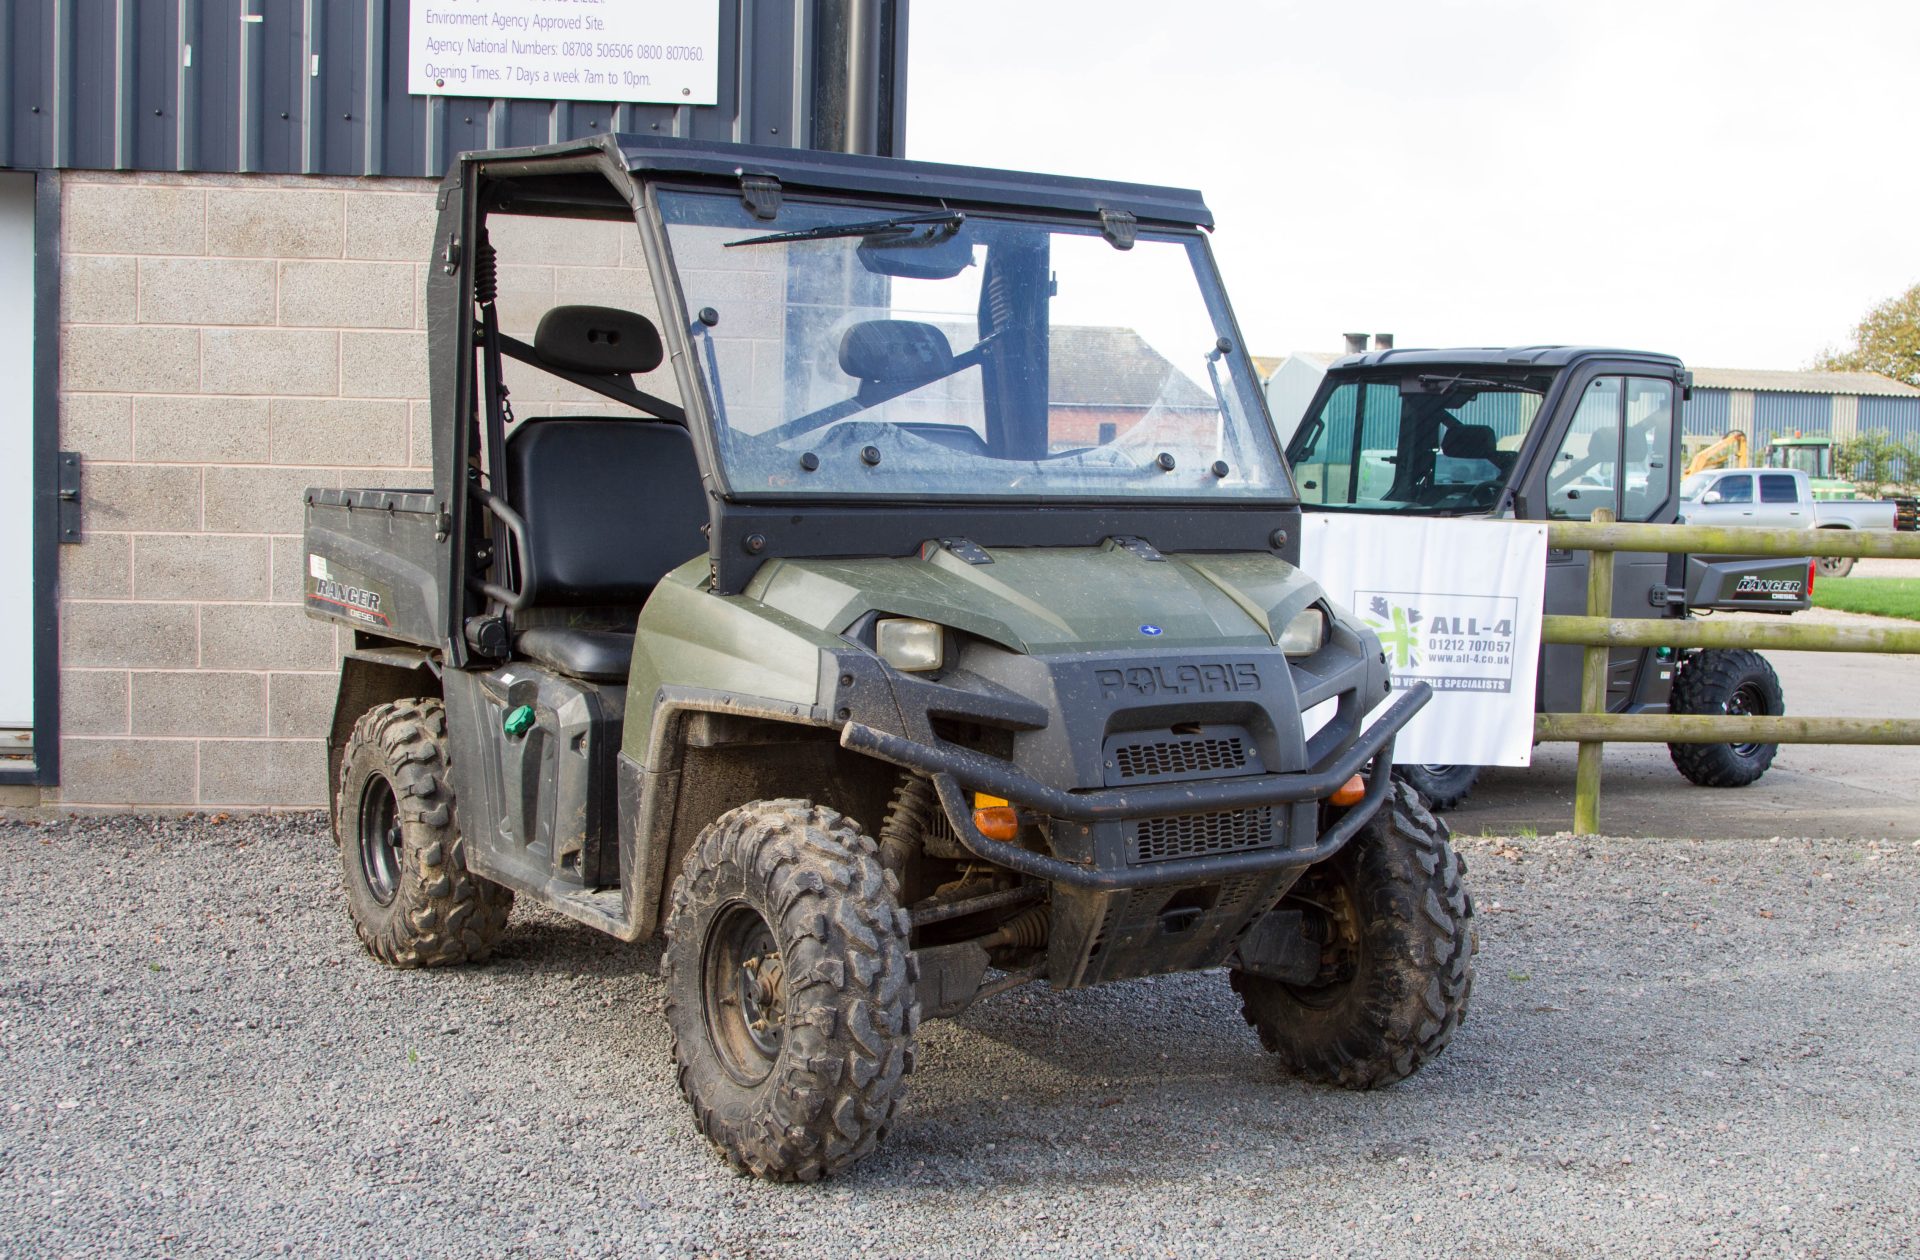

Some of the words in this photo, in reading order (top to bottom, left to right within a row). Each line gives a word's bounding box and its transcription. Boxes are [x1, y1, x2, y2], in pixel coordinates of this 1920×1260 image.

[426, 9, 488, 26] Environment
[492, 12, 529, 32] Agency
[533, 14, 581, 32] Approved
[586, 15, 605, 31] Site.
[426, 37, 464, 55] Agency
[468, 38, 508, 54] National
[512, 40, 558, 56] Numbers:
[562, 42, 593, 57] 08708
[597, 43, 633, 59] 506506
[637, 44, 662, 60] 0800
[666, 46, 704, 62] 807060.
[425, 63, 467, 82] Opening
[471, 65, 502, 81] Times.
[506, 67, 512, 80] 7
[517, 67, 540, 85] Days
[543, 71, 549, 82] a
[553, 68, 580, 84] week
[584, 69, 604, 84] 7am
[608, 72, 618, 85] to
[623, 70, 651, 88] 10pm.
[317, 579, 380, 612] RANGER
[1736, 579, 1801, 592] RANGER
[1430, 616, 1512, 637] ALL-4
[1429, 638, 1465, 651] 01212
[1468, 640, 1511, 653] 707057
[1428, 653, 1510, 665] www.all-4.co.uk
[1094, 663, 1262, 699] POLARIS
[1402, 677, 1443, 688] VECLE
[1444, 678, 1505, 690] SPECIALISTS
